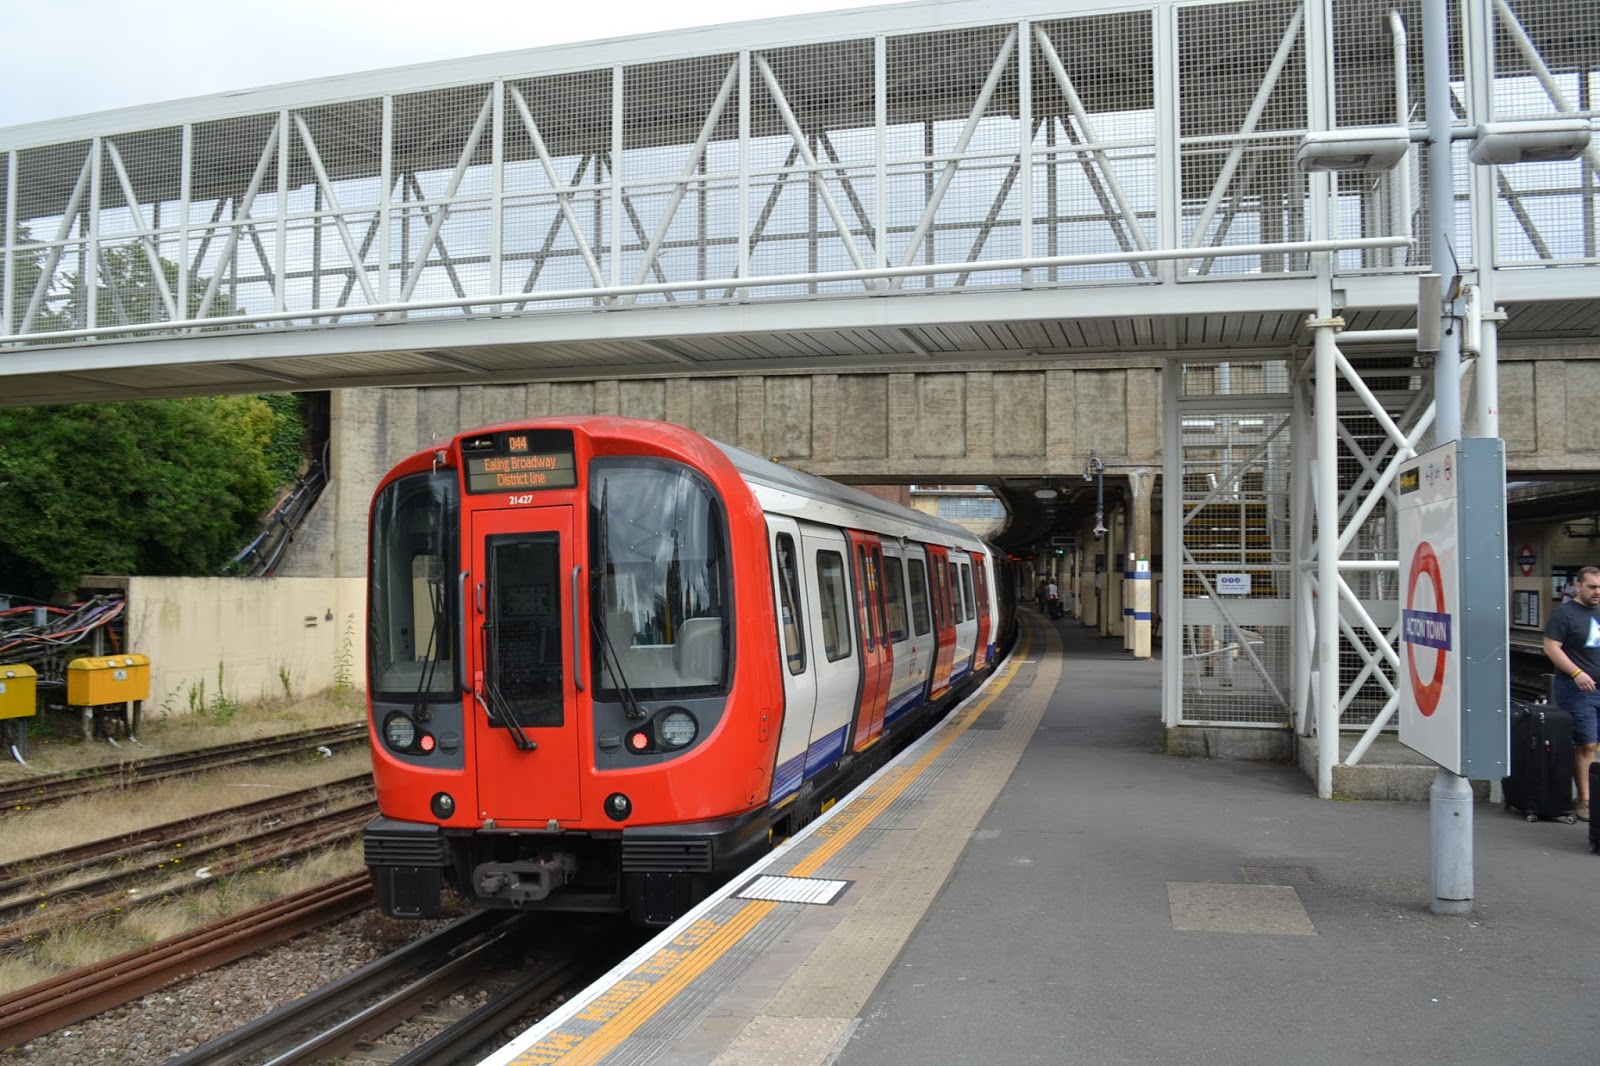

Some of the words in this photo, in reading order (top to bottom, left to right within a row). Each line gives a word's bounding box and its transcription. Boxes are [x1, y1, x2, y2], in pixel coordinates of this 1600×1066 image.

[509, 436, 527, 450] 044
[484, 457, 509, 472] Ealing
[511, 455, 556, 470] Broadway
[497, 472, 528, 486] District
[529, 471, 546, 484] line
[509, 495, 534, 505] 21427
[1407, 617, 1426, 638] ACTON
[1426, 619, 1447, 642] TOWN
